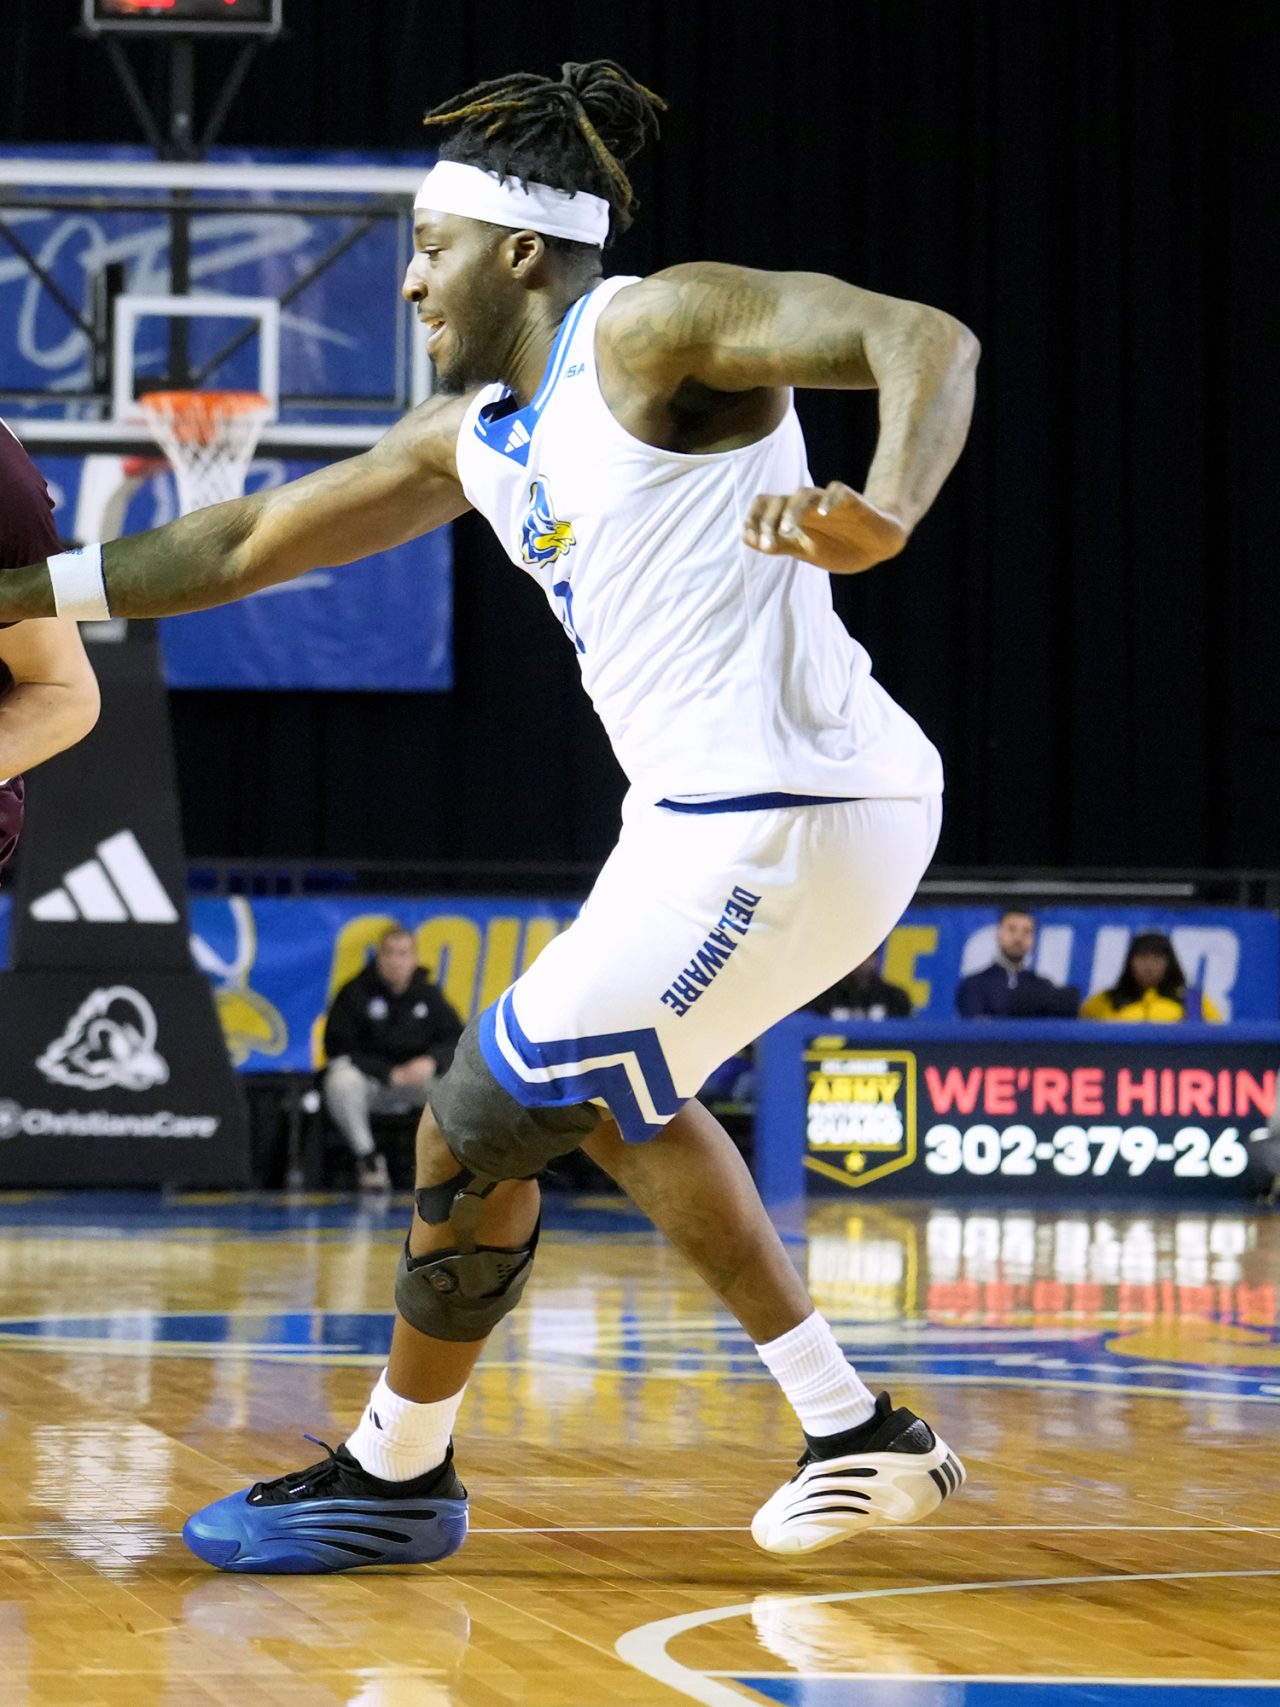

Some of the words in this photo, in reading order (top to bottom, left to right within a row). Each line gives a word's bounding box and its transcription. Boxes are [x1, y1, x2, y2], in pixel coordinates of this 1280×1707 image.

[660, 885, 762, 1017] DELAWARE
[925, 1066, 1105, 1115] WE'RE
[1117, 1068, 1277, 1118] HIRIN
[924, 1124, 1269, 1178] 302-379-26
